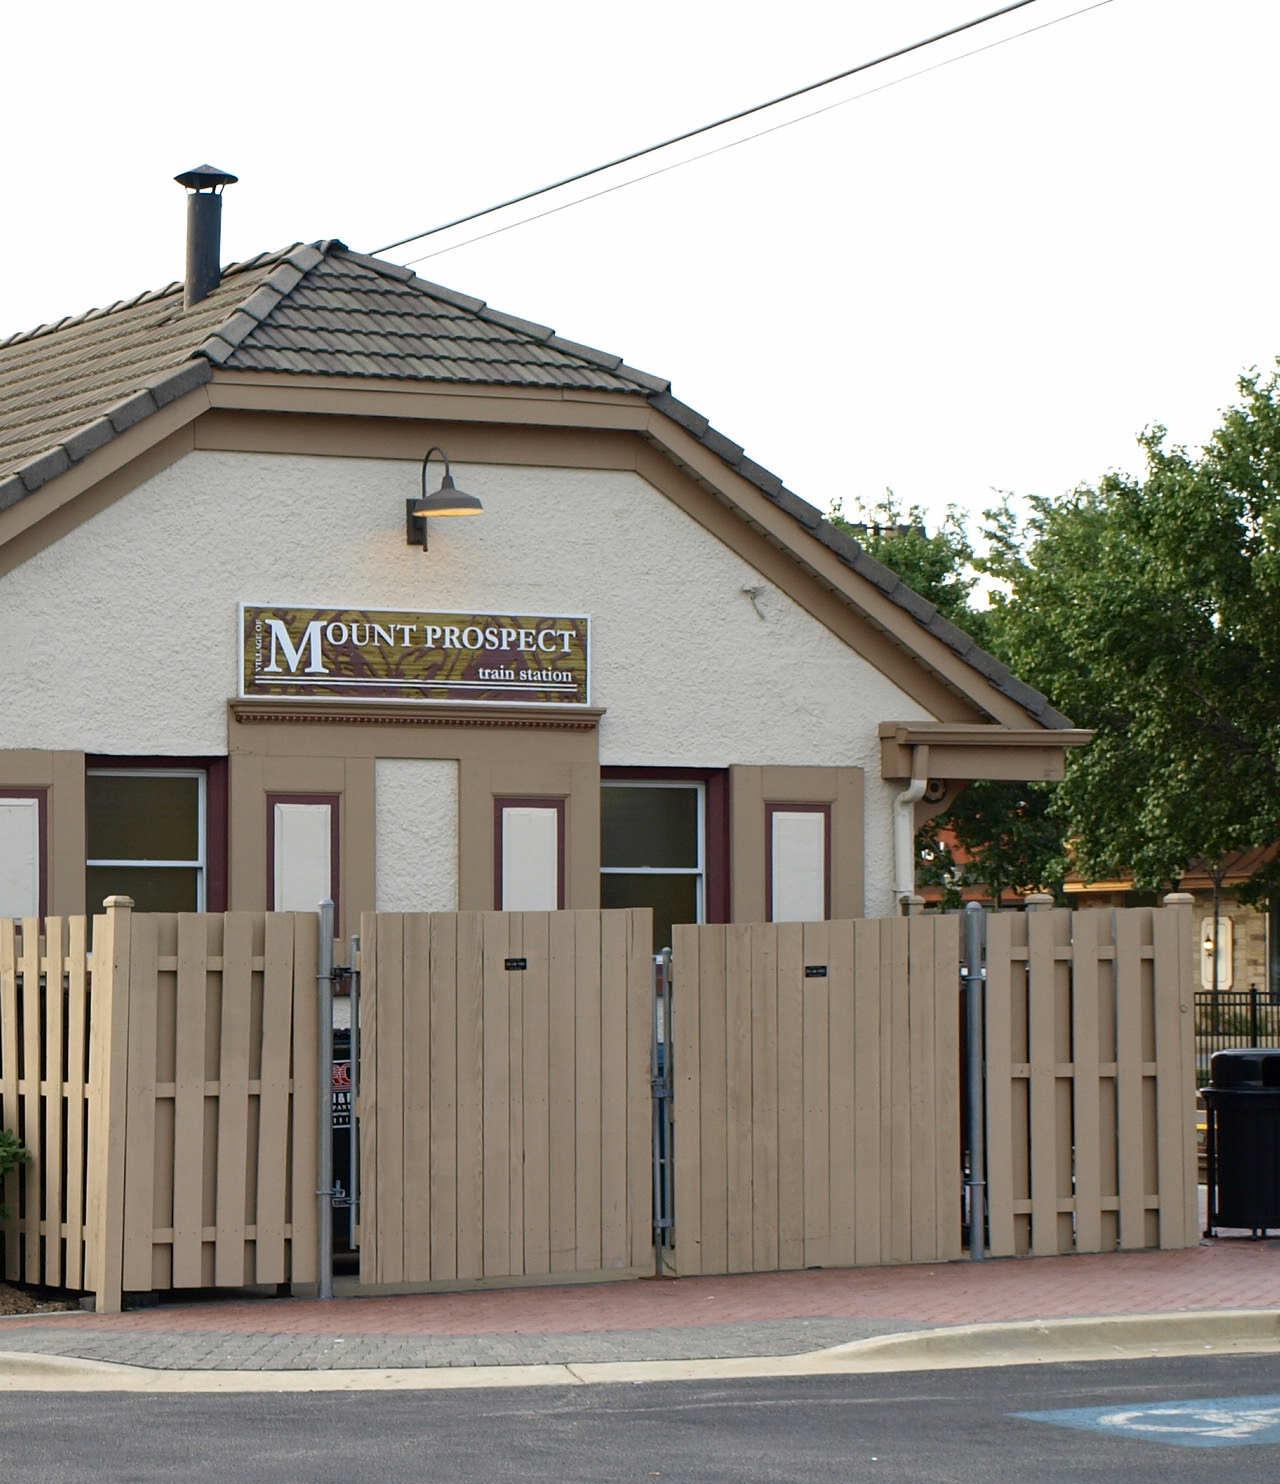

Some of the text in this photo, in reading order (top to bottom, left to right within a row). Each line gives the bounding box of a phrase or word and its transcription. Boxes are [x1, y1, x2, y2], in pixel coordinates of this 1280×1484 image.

[255, 619, 263, 672] VILLAGE OF
[264, 619, 577, 673] MOUNT PROSPECT
[478, 665, 572, 682] train station
